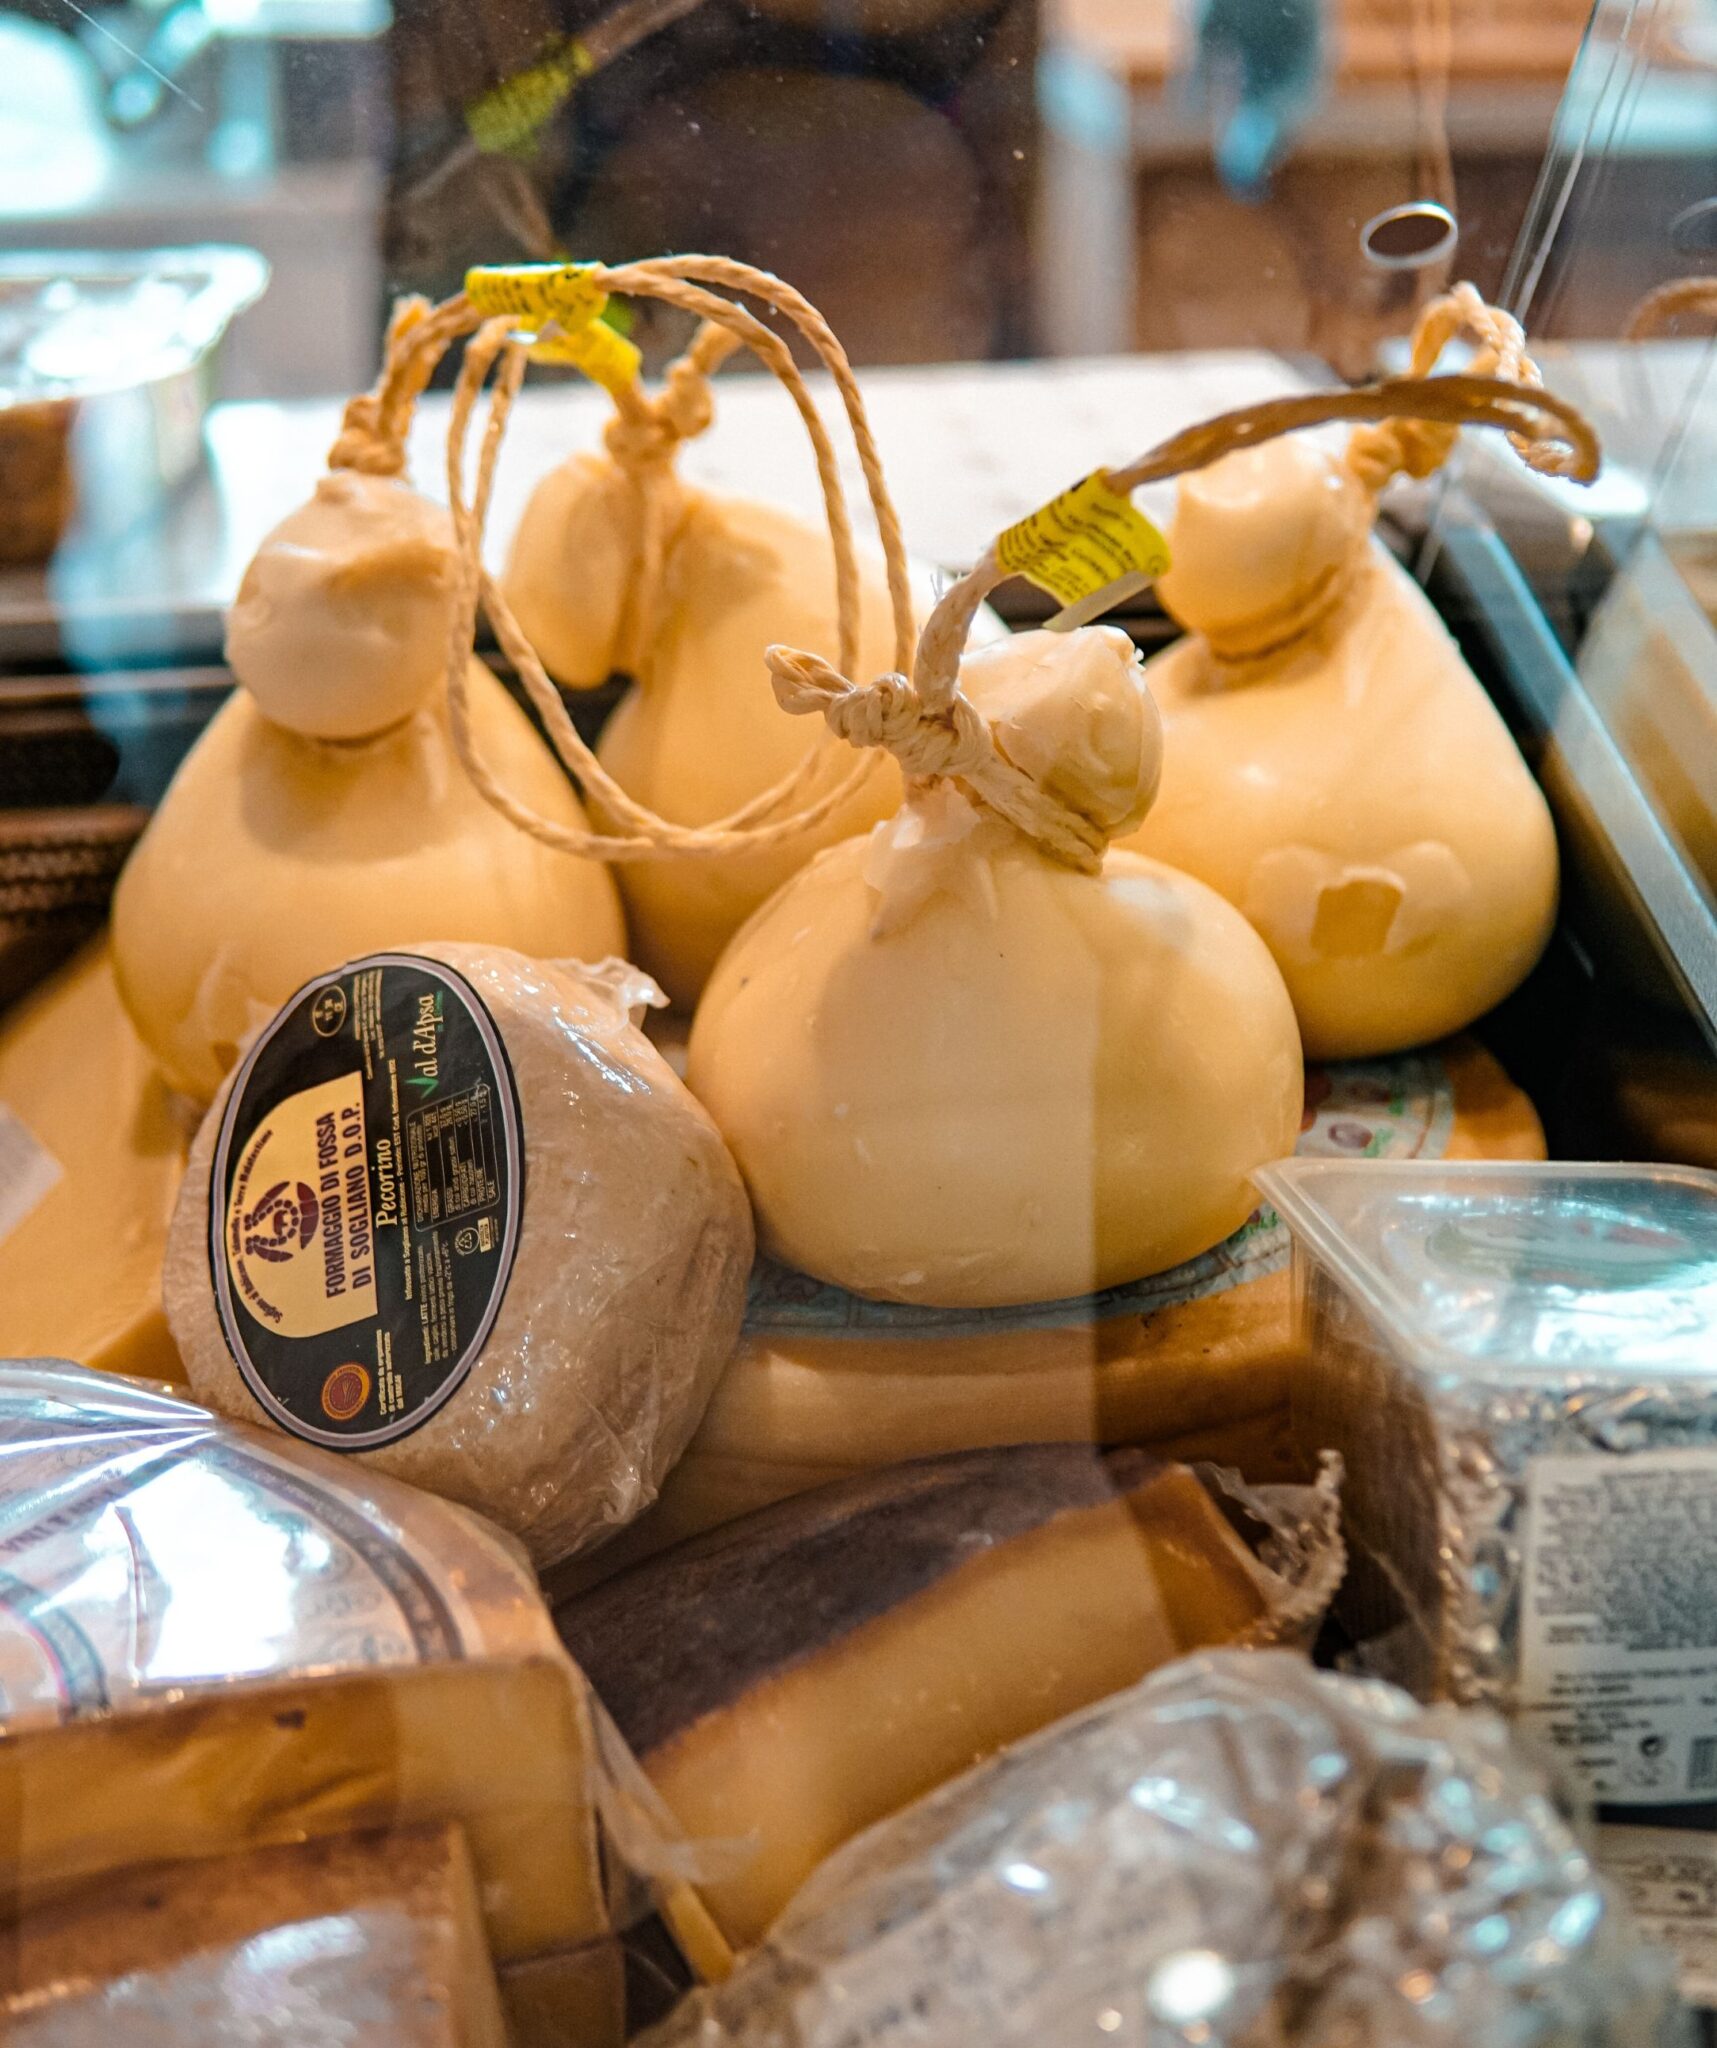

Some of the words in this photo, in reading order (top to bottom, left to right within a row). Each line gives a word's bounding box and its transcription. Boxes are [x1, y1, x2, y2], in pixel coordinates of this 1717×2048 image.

[316, 1112, 338, 1169] FOSSA
[341, 1102, 362, 1158] D.O.P.
[320, 1171, 340, 1192] DI
[371, 1139, 398, 1228] Pecorino
[488, 1180, 496, 1198] SALE
[346, 1165, 370, 1260] SOGLIANO
[399, 1182, 407, 1217] Rubicone
[321, 1194, 346, 1298] FORMAGGIO
[402, 1226, 411, 1258] Sogliano
[352, 1266, 372, 1289] DI
[404, 1265, 412, 1300] Infossato
[420, 1303, 428, 1325] LATTE
